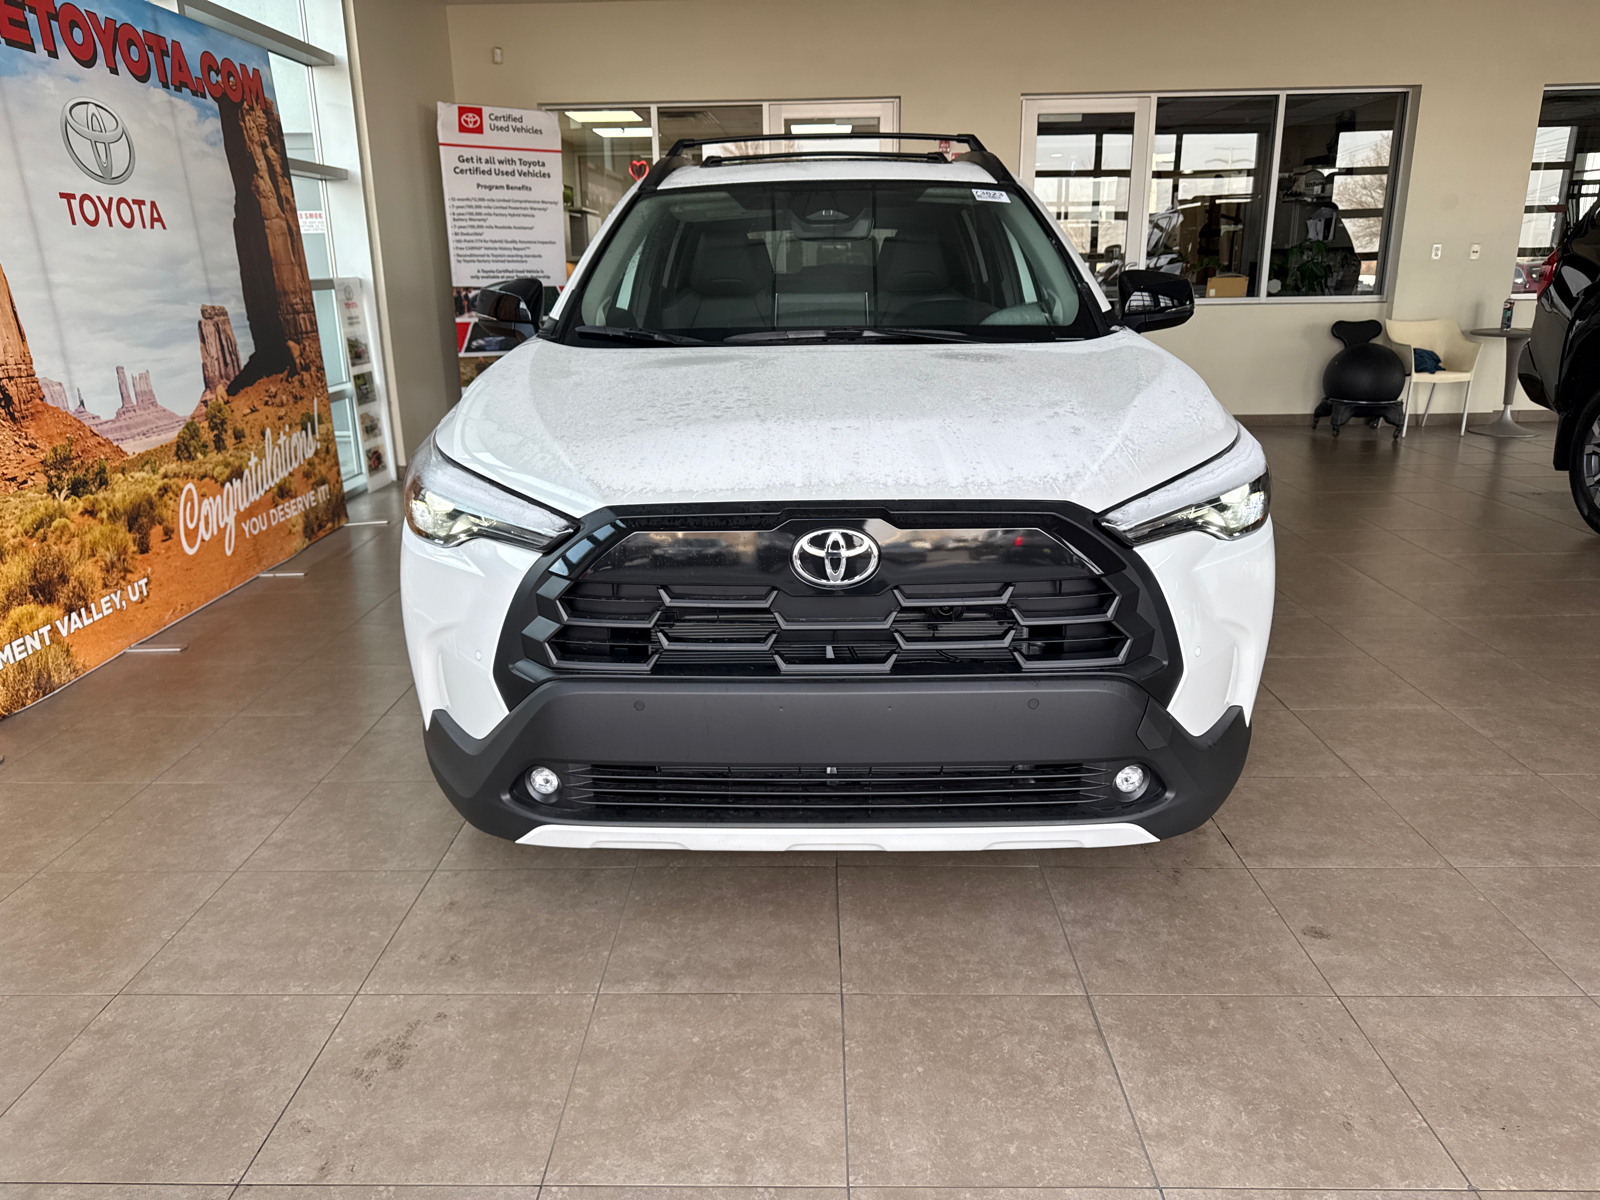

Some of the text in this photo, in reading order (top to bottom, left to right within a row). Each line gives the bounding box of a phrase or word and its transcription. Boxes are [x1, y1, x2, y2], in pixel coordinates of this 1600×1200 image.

[488, 113, 523, 123] Certified
[489, 123, 543, 135] Used Vehicles
[458, 155, 546, 168] Get it all with Toyota
[453, 166, 551, 179] Certified Used Vehicles
[476, 183, 532, 192] Program Benefits
[58, 191, 167, 230] TOYOTA
[179, 397, 321, 556] Congratulations!
[241, 483, 330, 539] YOU DESERVE IT!
[55, 589, 127, 638] VALLEY,
[127, 577, 148, 602] UT
